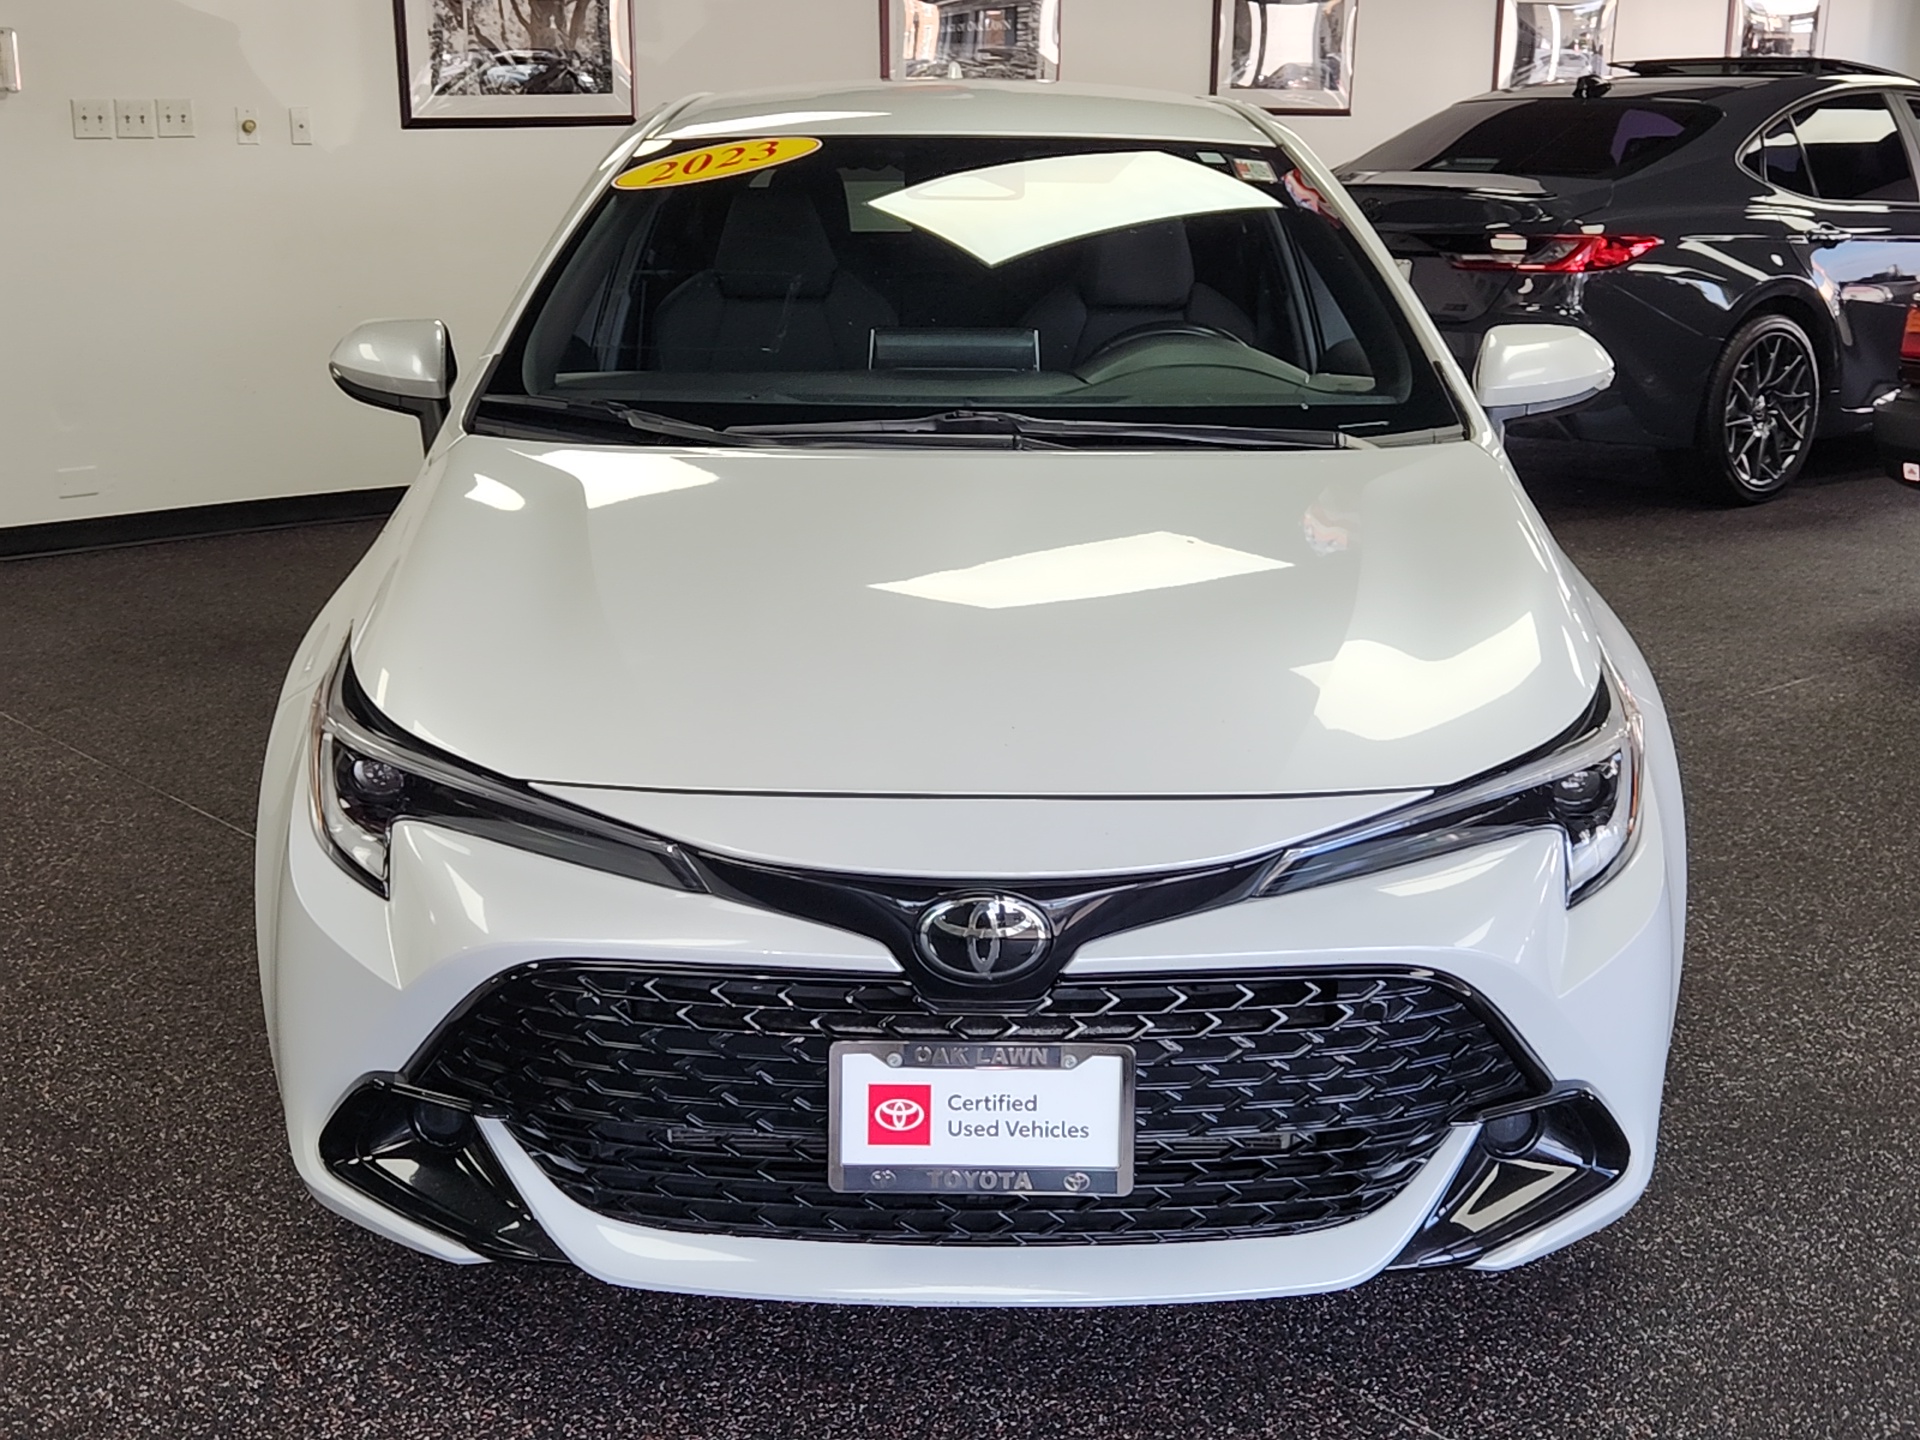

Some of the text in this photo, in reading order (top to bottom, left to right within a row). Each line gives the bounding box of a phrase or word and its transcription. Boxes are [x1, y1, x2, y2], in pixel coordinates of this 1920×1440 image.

[646, 140, 780, 184] 2023
[914, 1046, 1048, 1065] OAK LAWN
[947, 1093, 1038, 1112] Certified
[947, 1119, 1090, 1139] Used Vehicles
[927, 1170, 1034, 1190] TOYOTA
